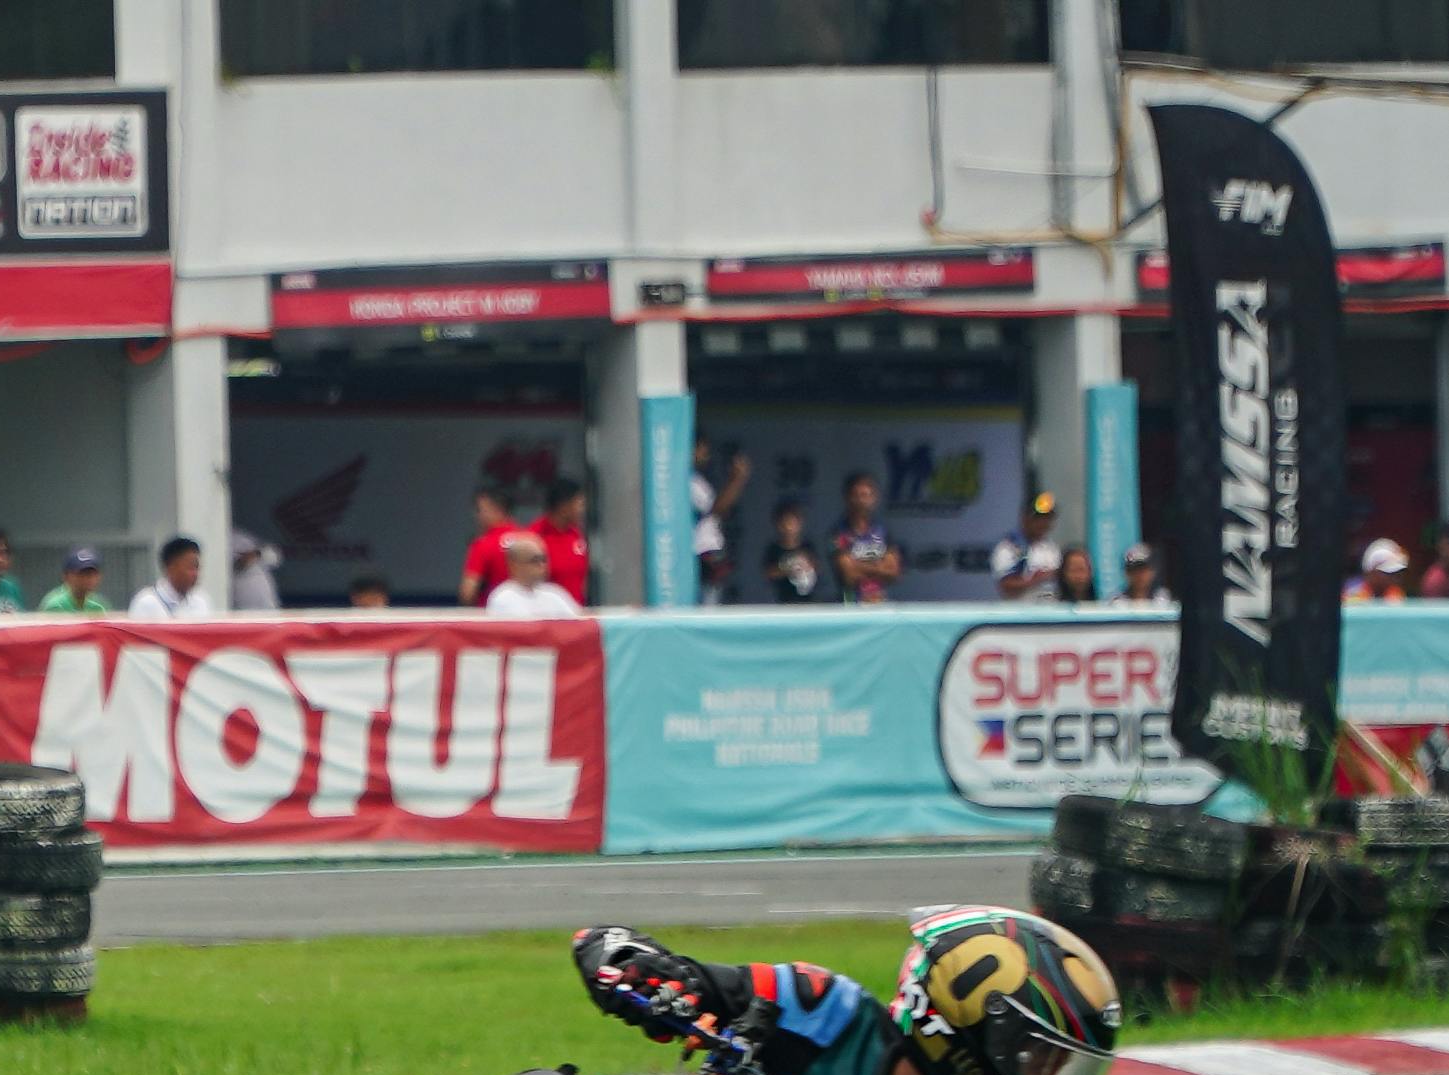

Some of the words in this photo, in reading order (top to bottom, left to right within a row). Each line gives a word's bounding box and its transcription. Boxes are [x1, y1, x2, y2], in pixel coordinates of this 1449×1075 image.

[27, 153, 136, 183] RACING
[1274, 386, 1299, 548] RACING
[971, 649, 1162, 706] SUPER
[31, 643, 582, 823] MOTUL
[1012, 711, 1177, 767] SERIE
